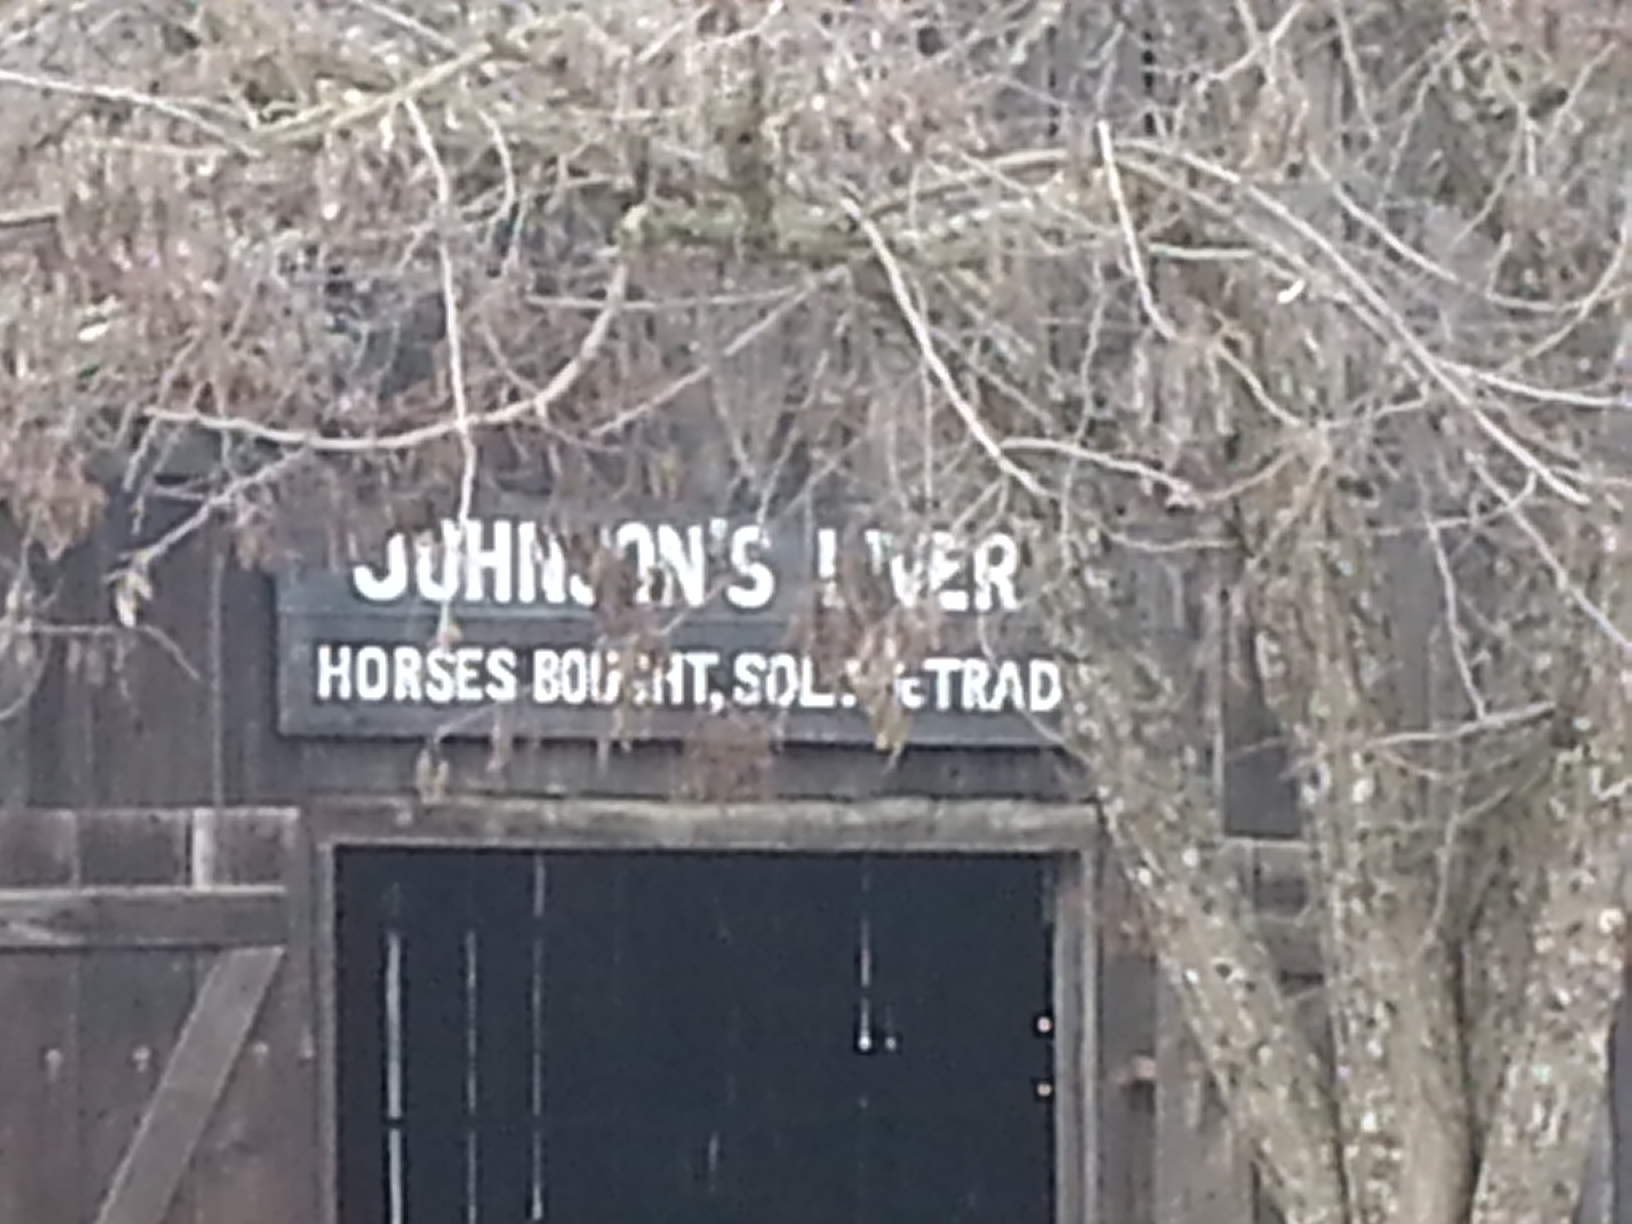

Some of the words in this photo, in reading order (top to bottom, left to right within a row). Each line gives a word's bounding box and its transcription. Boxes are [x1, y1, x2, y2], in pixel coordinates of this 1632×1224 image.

[818, 528, 1020, 611] LIVER
[317, 645, 518, 703] HORSES
[732, 652, 862, 709] SOL
[923, 657, 1063, 711] TRAD
